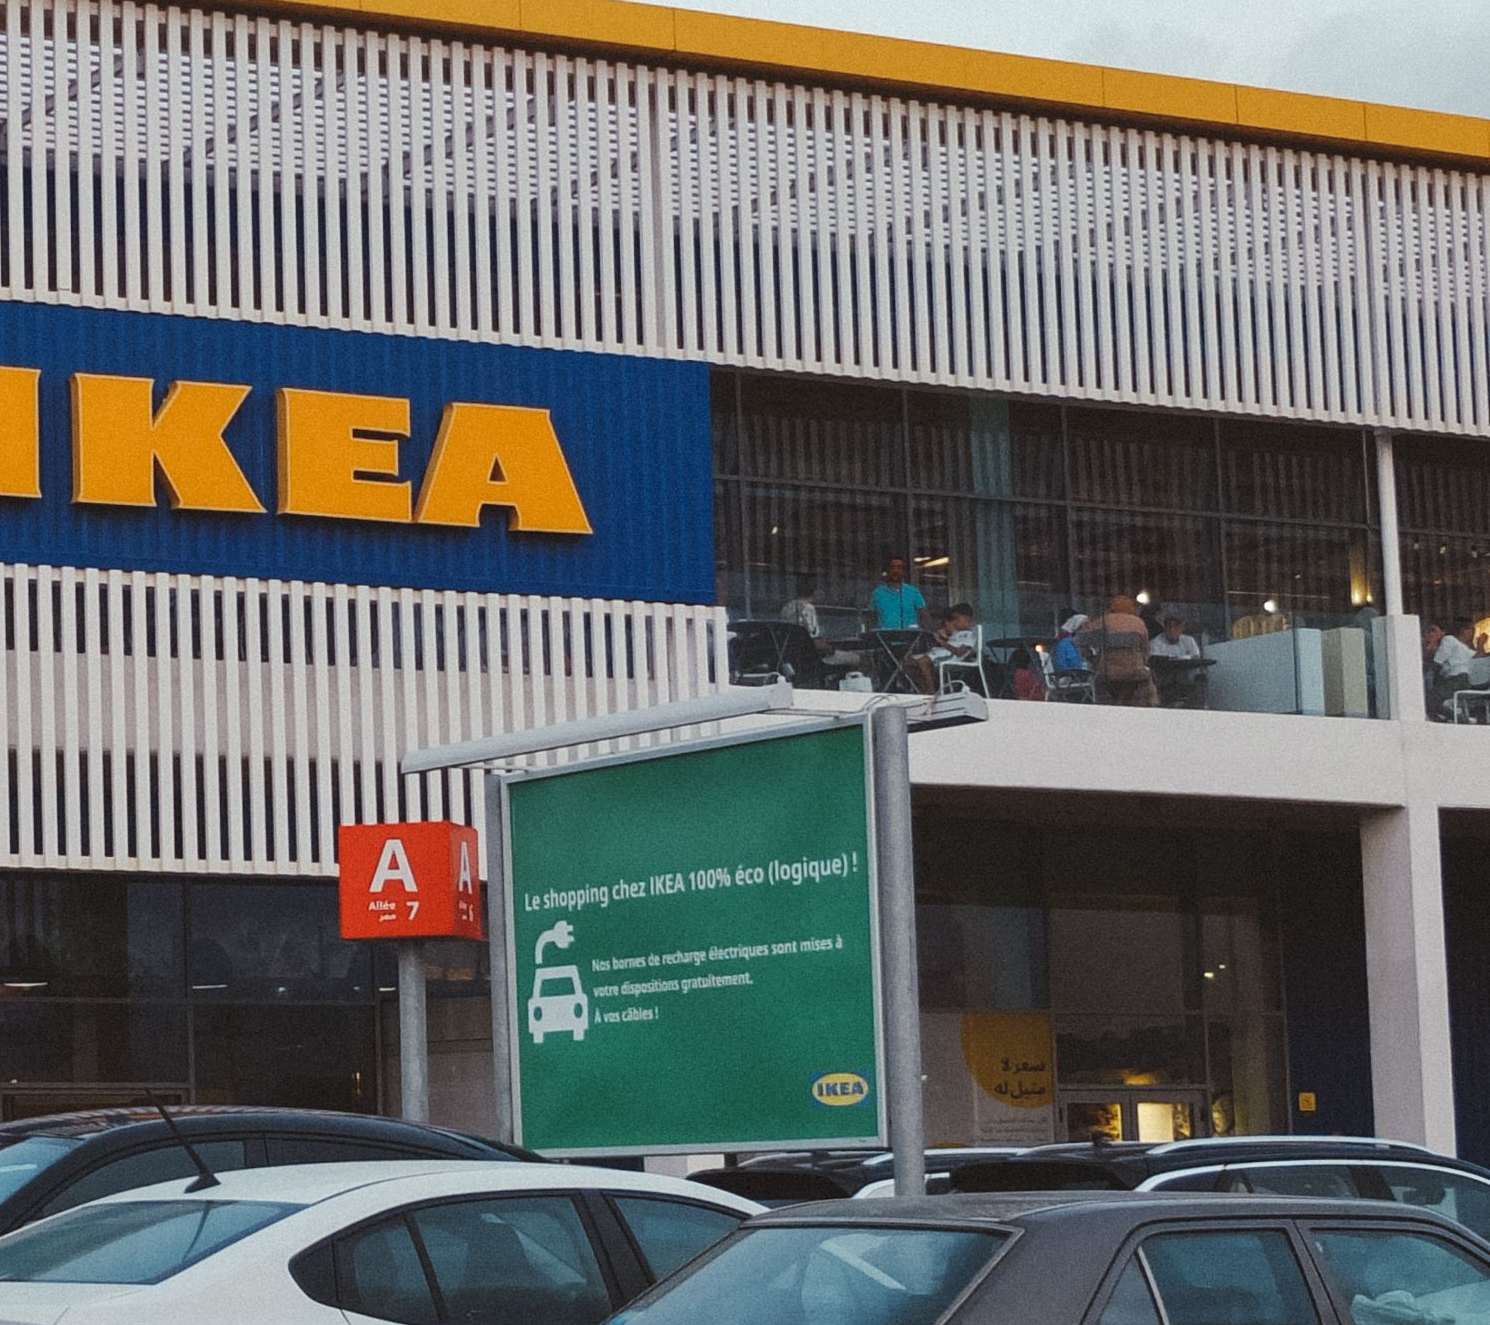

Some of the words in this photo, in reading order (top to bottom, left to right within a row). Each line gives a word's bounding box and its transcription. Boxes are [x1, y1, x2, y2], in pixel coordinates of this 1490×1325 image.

[368, 838, 419, 893] A
[458, 841, 473, 895] A
[524, 892, 540, 911] Le
[543, 883, 609, 911] shopping
[612, 879, 646, 900] chez
[649, 872, 685, 896] IKEA
[688, 867, 731, 892] 100%
[735, 864, 764, 887] éco
[767, 852, 848, 885] (logique)
[368, 899, 396, 911] Allée
[406, 901, 420, 921] 7
[591, 958, 611, 972] Nos
[612, 956, 646, 970] bornes
[647, 954, 661, 967] de
[662, 949, 706, 966] recharge
[708, 942, 769, 961] électriques
[770, 940, 798, 955] sont
[800, 936, 833, 952] mises
[835, 933, 844, 949] à
[593, 984, 619, 997] votre
[620, 978, 680, 997] dispositions
[603, 1011, 620, 1023] vos
[621, 1006, 653, 1022] câbles
[817, 1081, 865, 1097] IKEA
